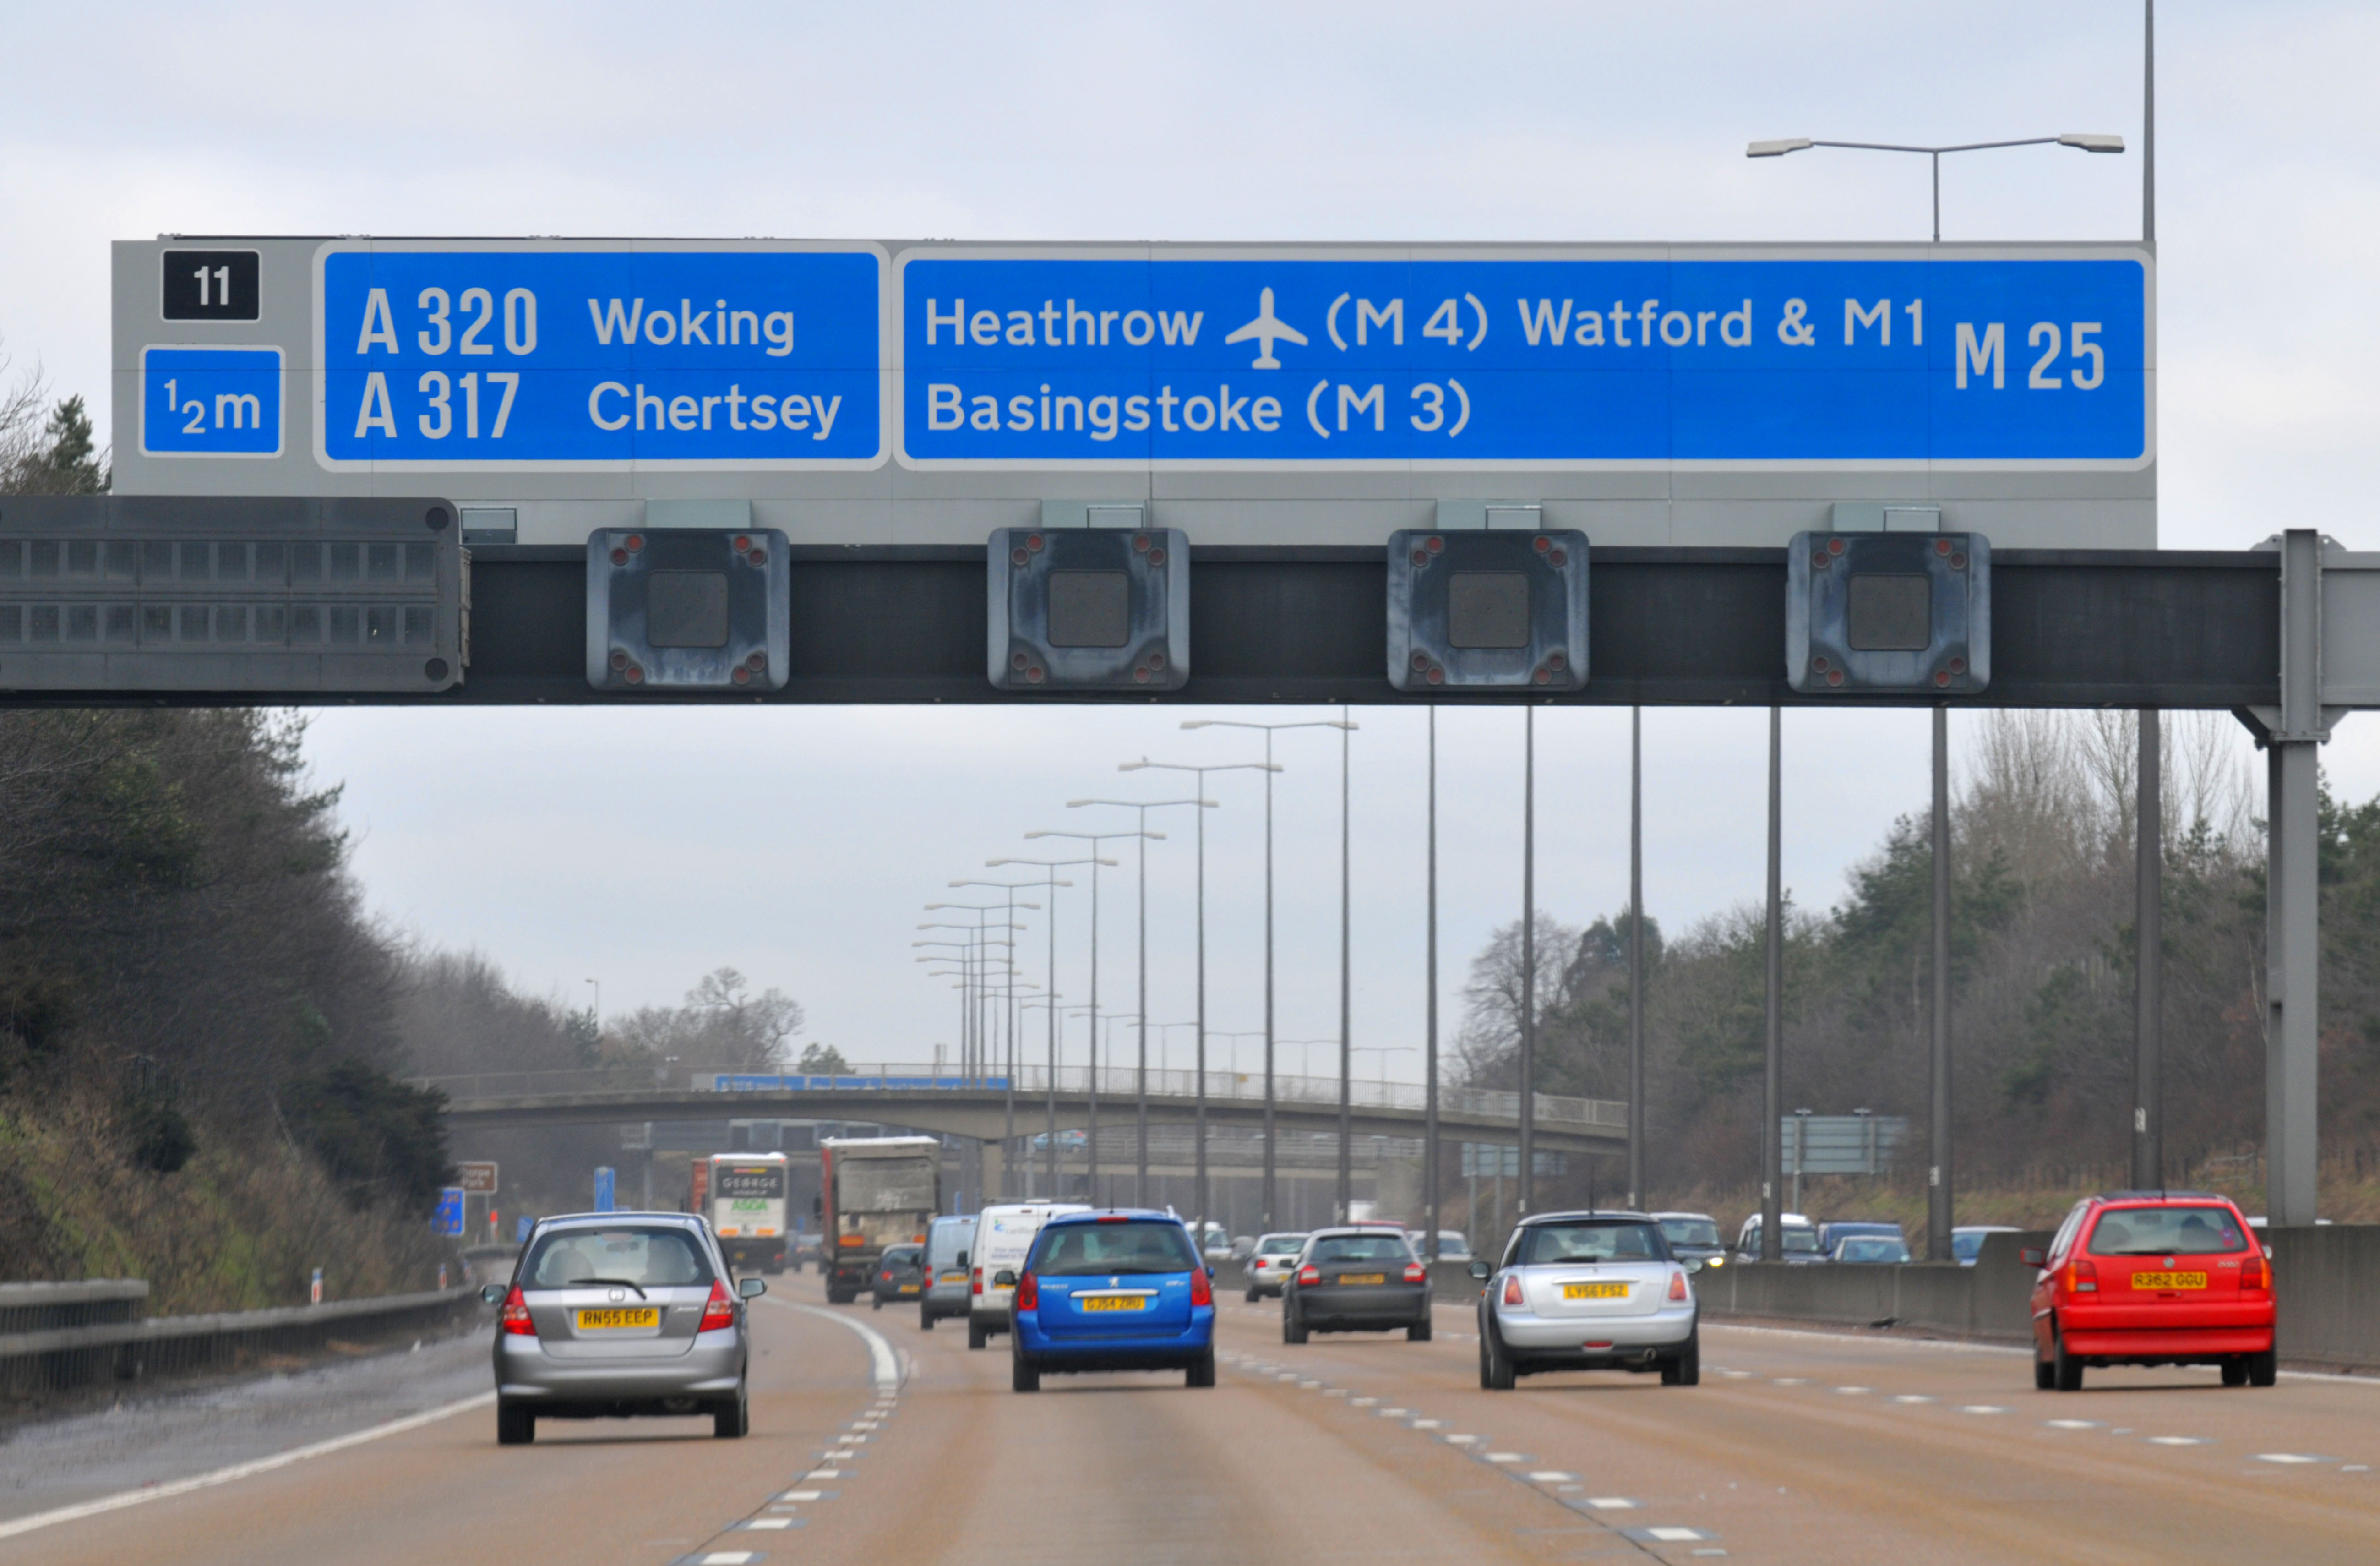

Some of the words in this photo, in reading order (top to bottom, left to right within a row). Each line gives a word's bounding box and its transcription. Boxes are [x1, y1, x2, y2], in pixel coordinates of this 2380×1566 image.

[194, 266, 229, 306] 11
[357, 288, 399, 354] A
[418, 287, 537, 355] 320
[588, 298, 794, 357] Woking
[927, 299, 1204, 346] Heathrow
[1518, 299, 1752, 347] Watford
[1778, 298, 1815, 346] &
[1956, 322, 2004, 389] M
[2028, 322, 2104, 390] 25
[354, 372, 397, 438] A
[419, 371, 519, 439] 317
[588, 381, 842, 440] Chertsey
[928, 383, 1282, 441] Basingstoke
[459, 1167, 490, 1179] horpe
[462, 1177, 485, 1188] Park
[723, 1177, 778, 1188] GEORGE
[731, 1199, 768, 1211] ASDA
[2135, 1274, 2172, 1286] R362
[2176, 1273, 2204, 1286] GGU
[584, 1310, 621, 1325] RN55
[625, 1310, 652, 1324] EEP
